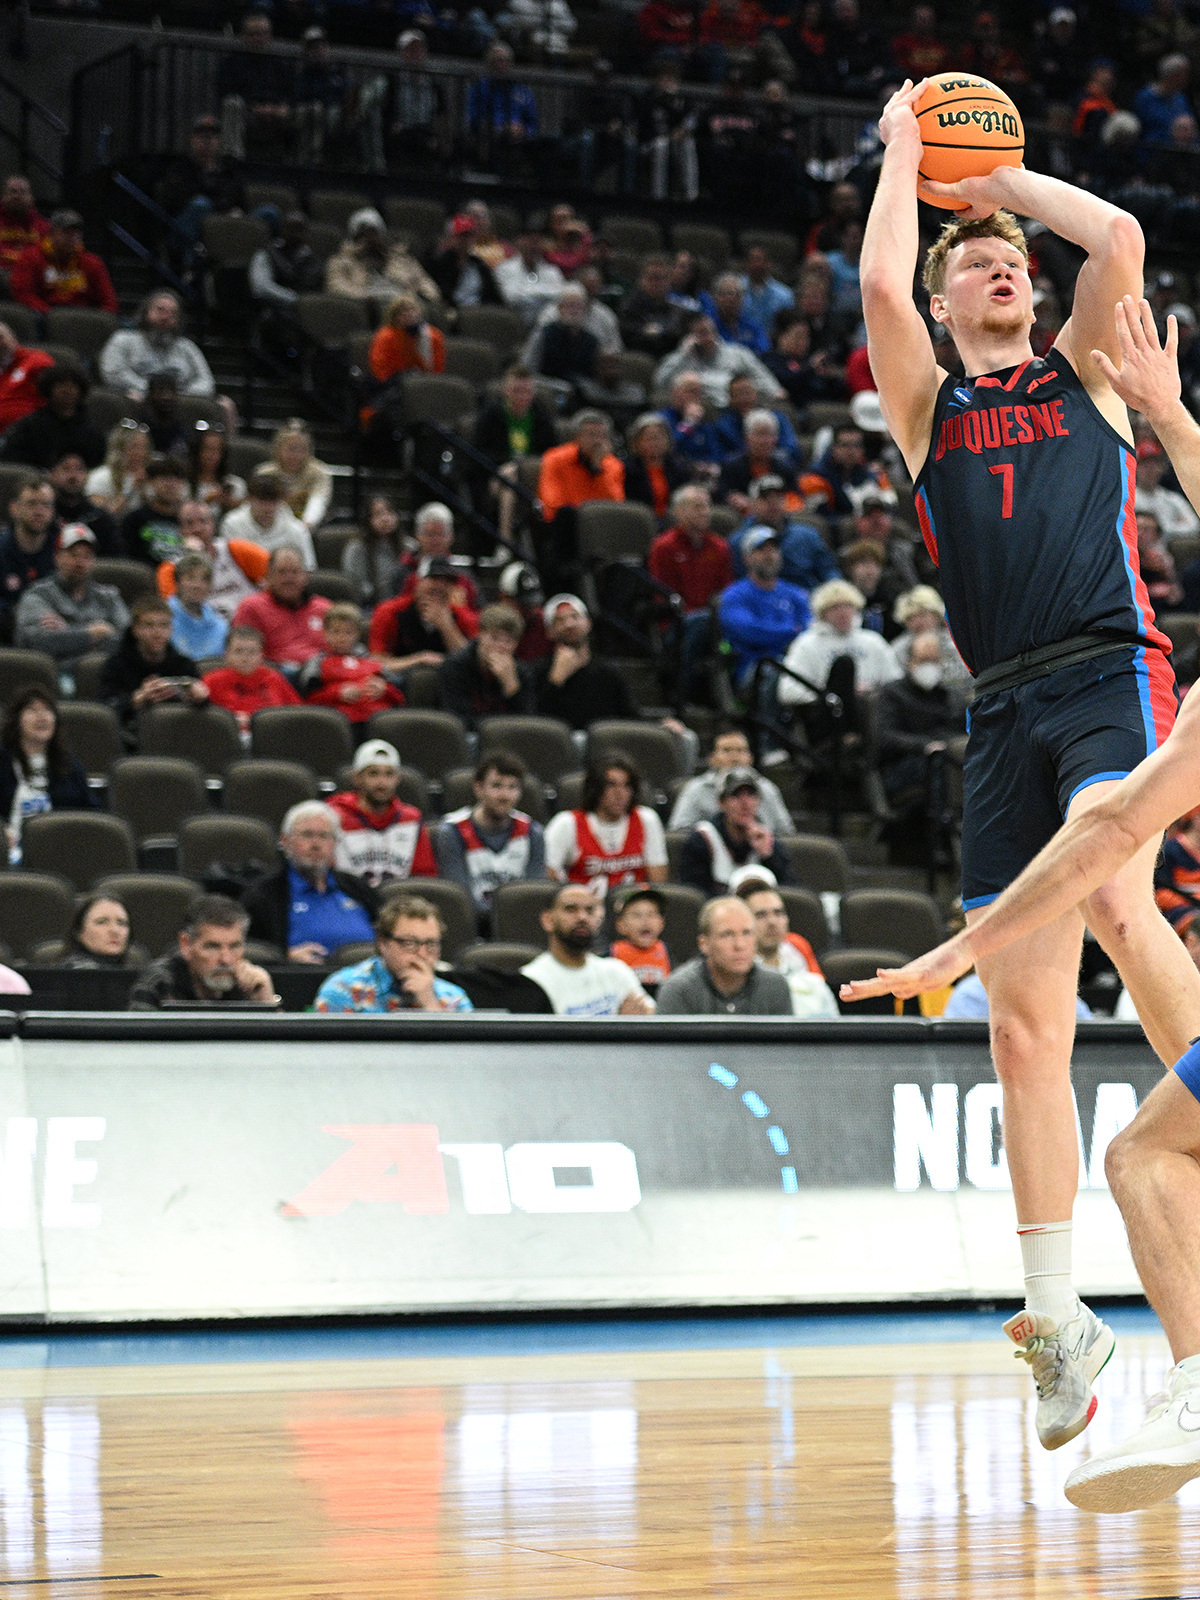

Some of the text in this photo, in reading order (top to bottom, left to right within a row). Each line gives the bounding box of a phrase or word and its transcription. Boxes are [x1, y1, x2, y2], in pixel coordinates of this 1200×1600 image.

[937, 110, 1019, 138] Wilson
[935, 399, 1070, 461] DUQUESNE
[988, 463, 1014, 519] 7
[281, 1124, 642, 1215] A10
